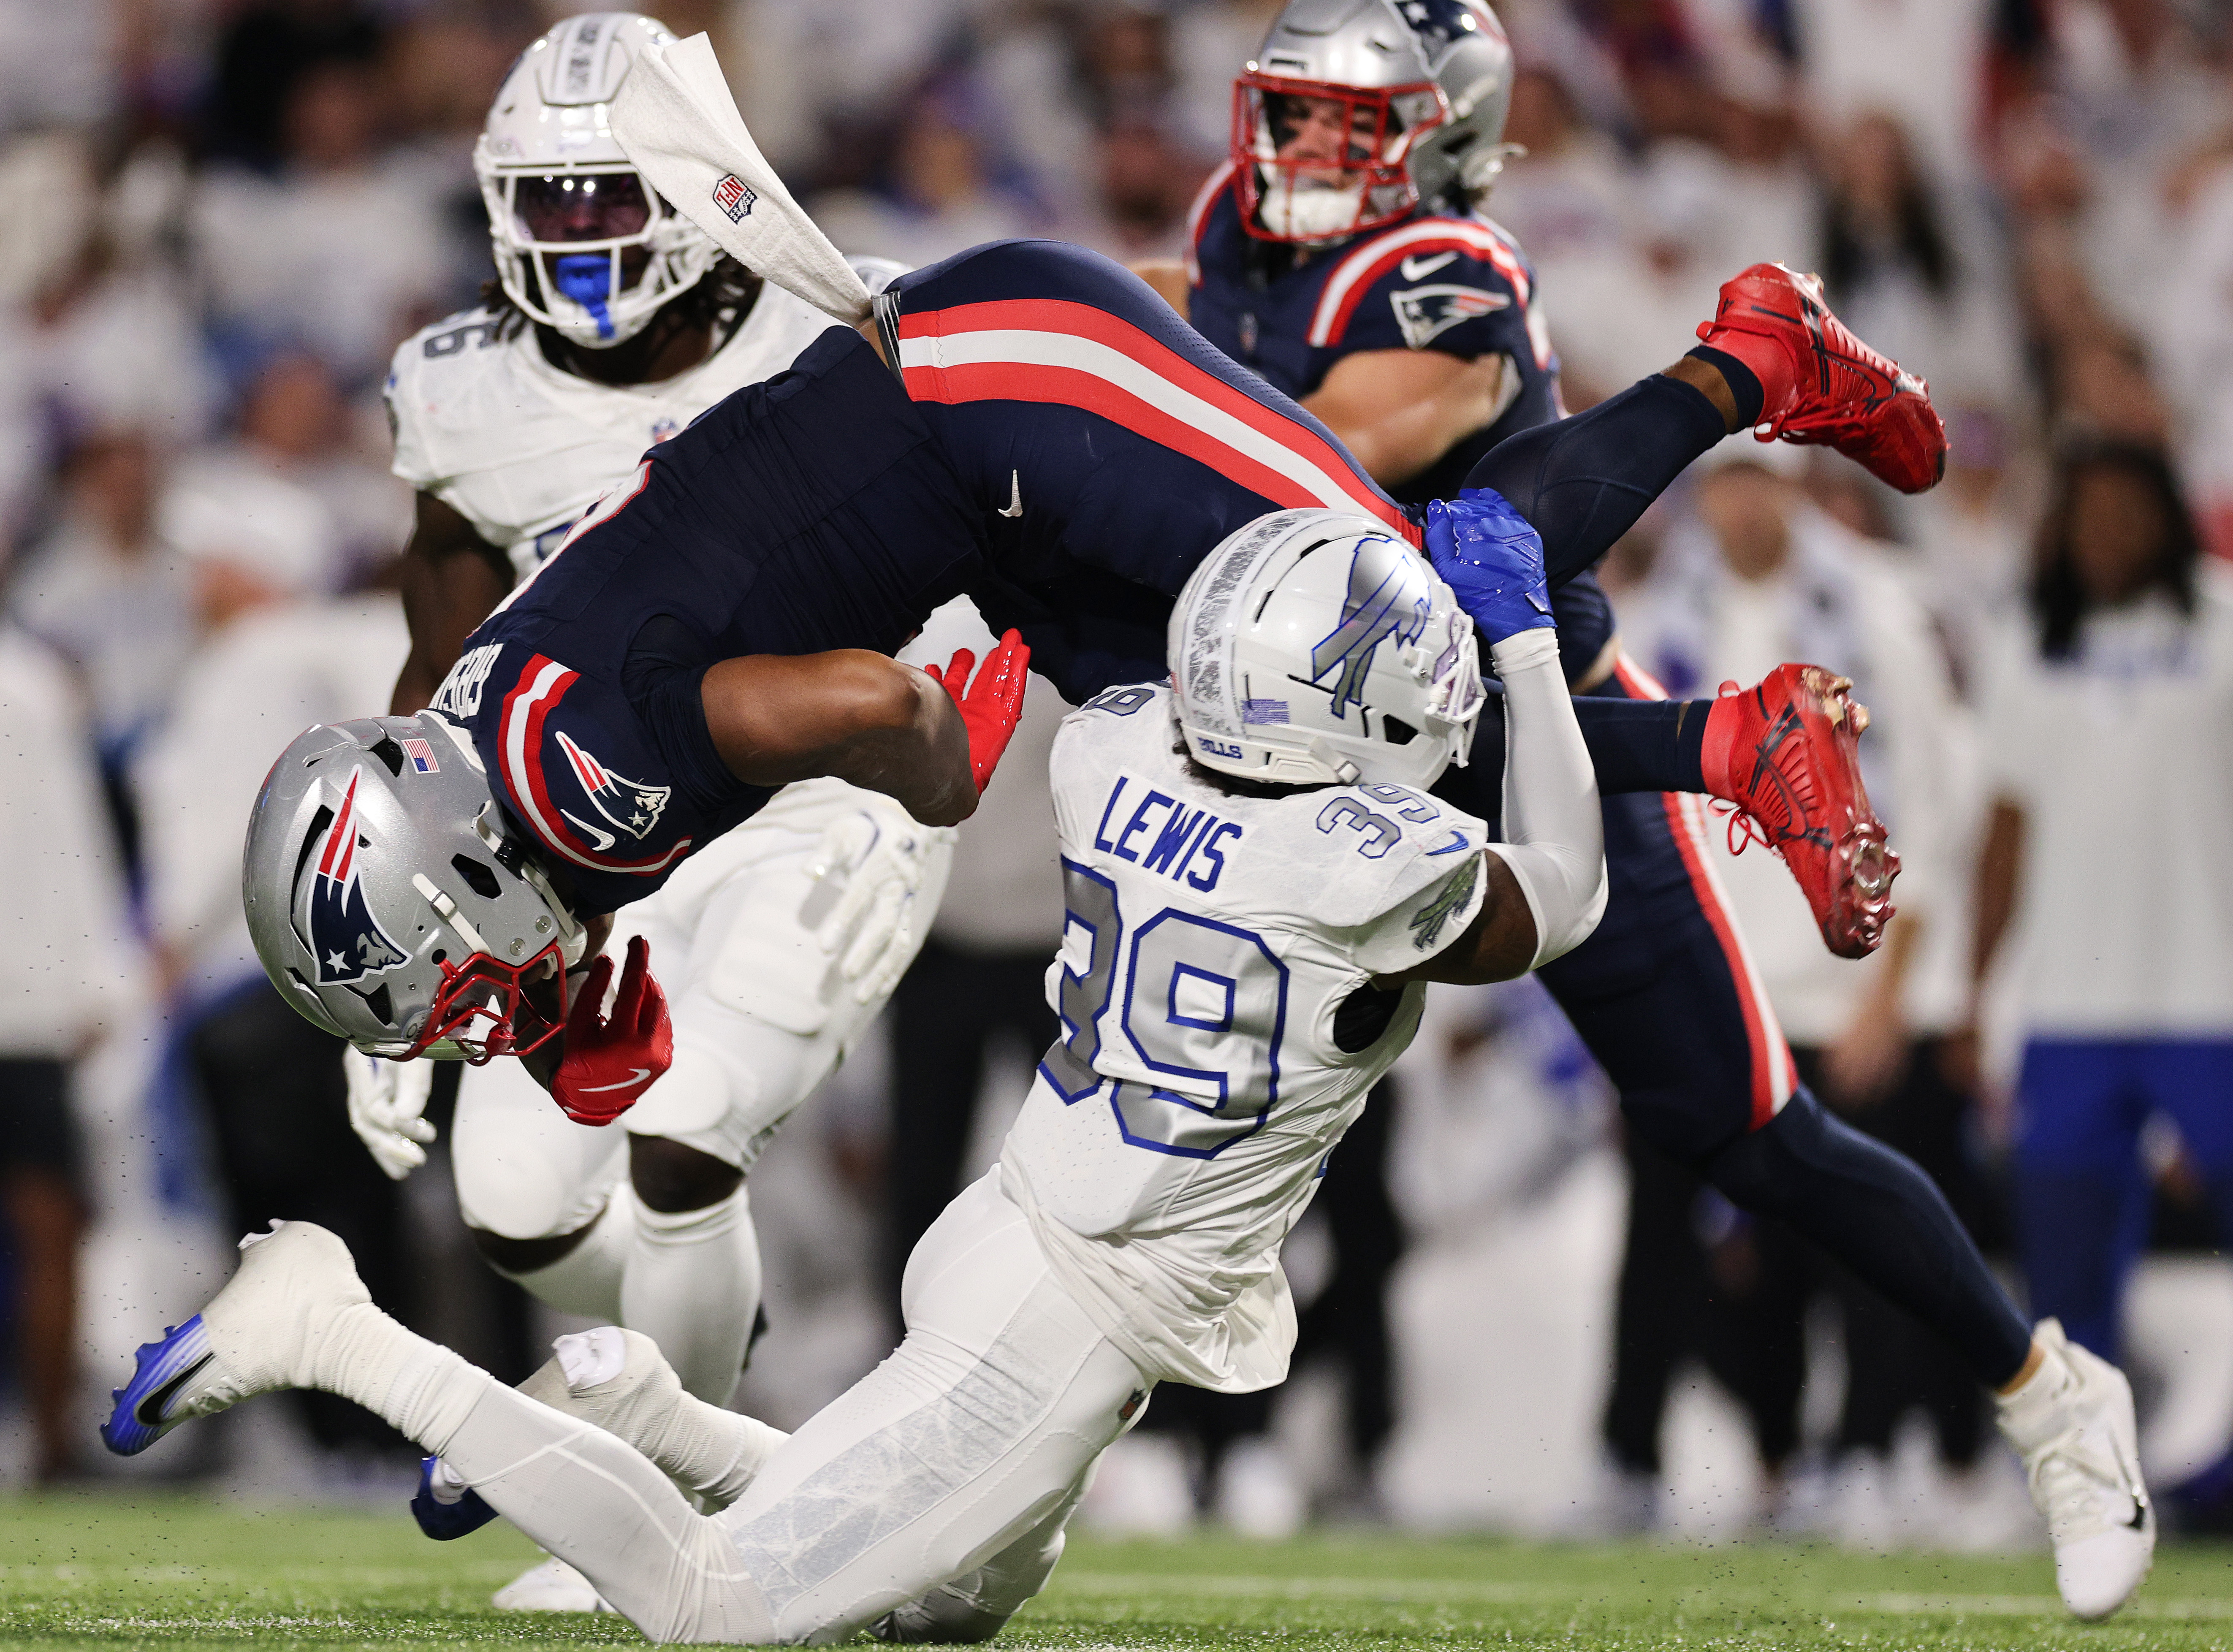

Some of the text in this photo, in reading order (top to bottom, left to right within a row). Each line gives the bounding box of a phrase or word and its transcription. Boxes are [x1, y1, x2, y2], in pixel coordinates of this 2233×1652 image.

[716, 177, 746, 208] NFL
[427, 642, 504, 720] GIBS
[1094, 776, 1243, 893] LEWIS
[1316, 782, 1441, 860] 39
[1036, 854, 1290, 1160] 39
